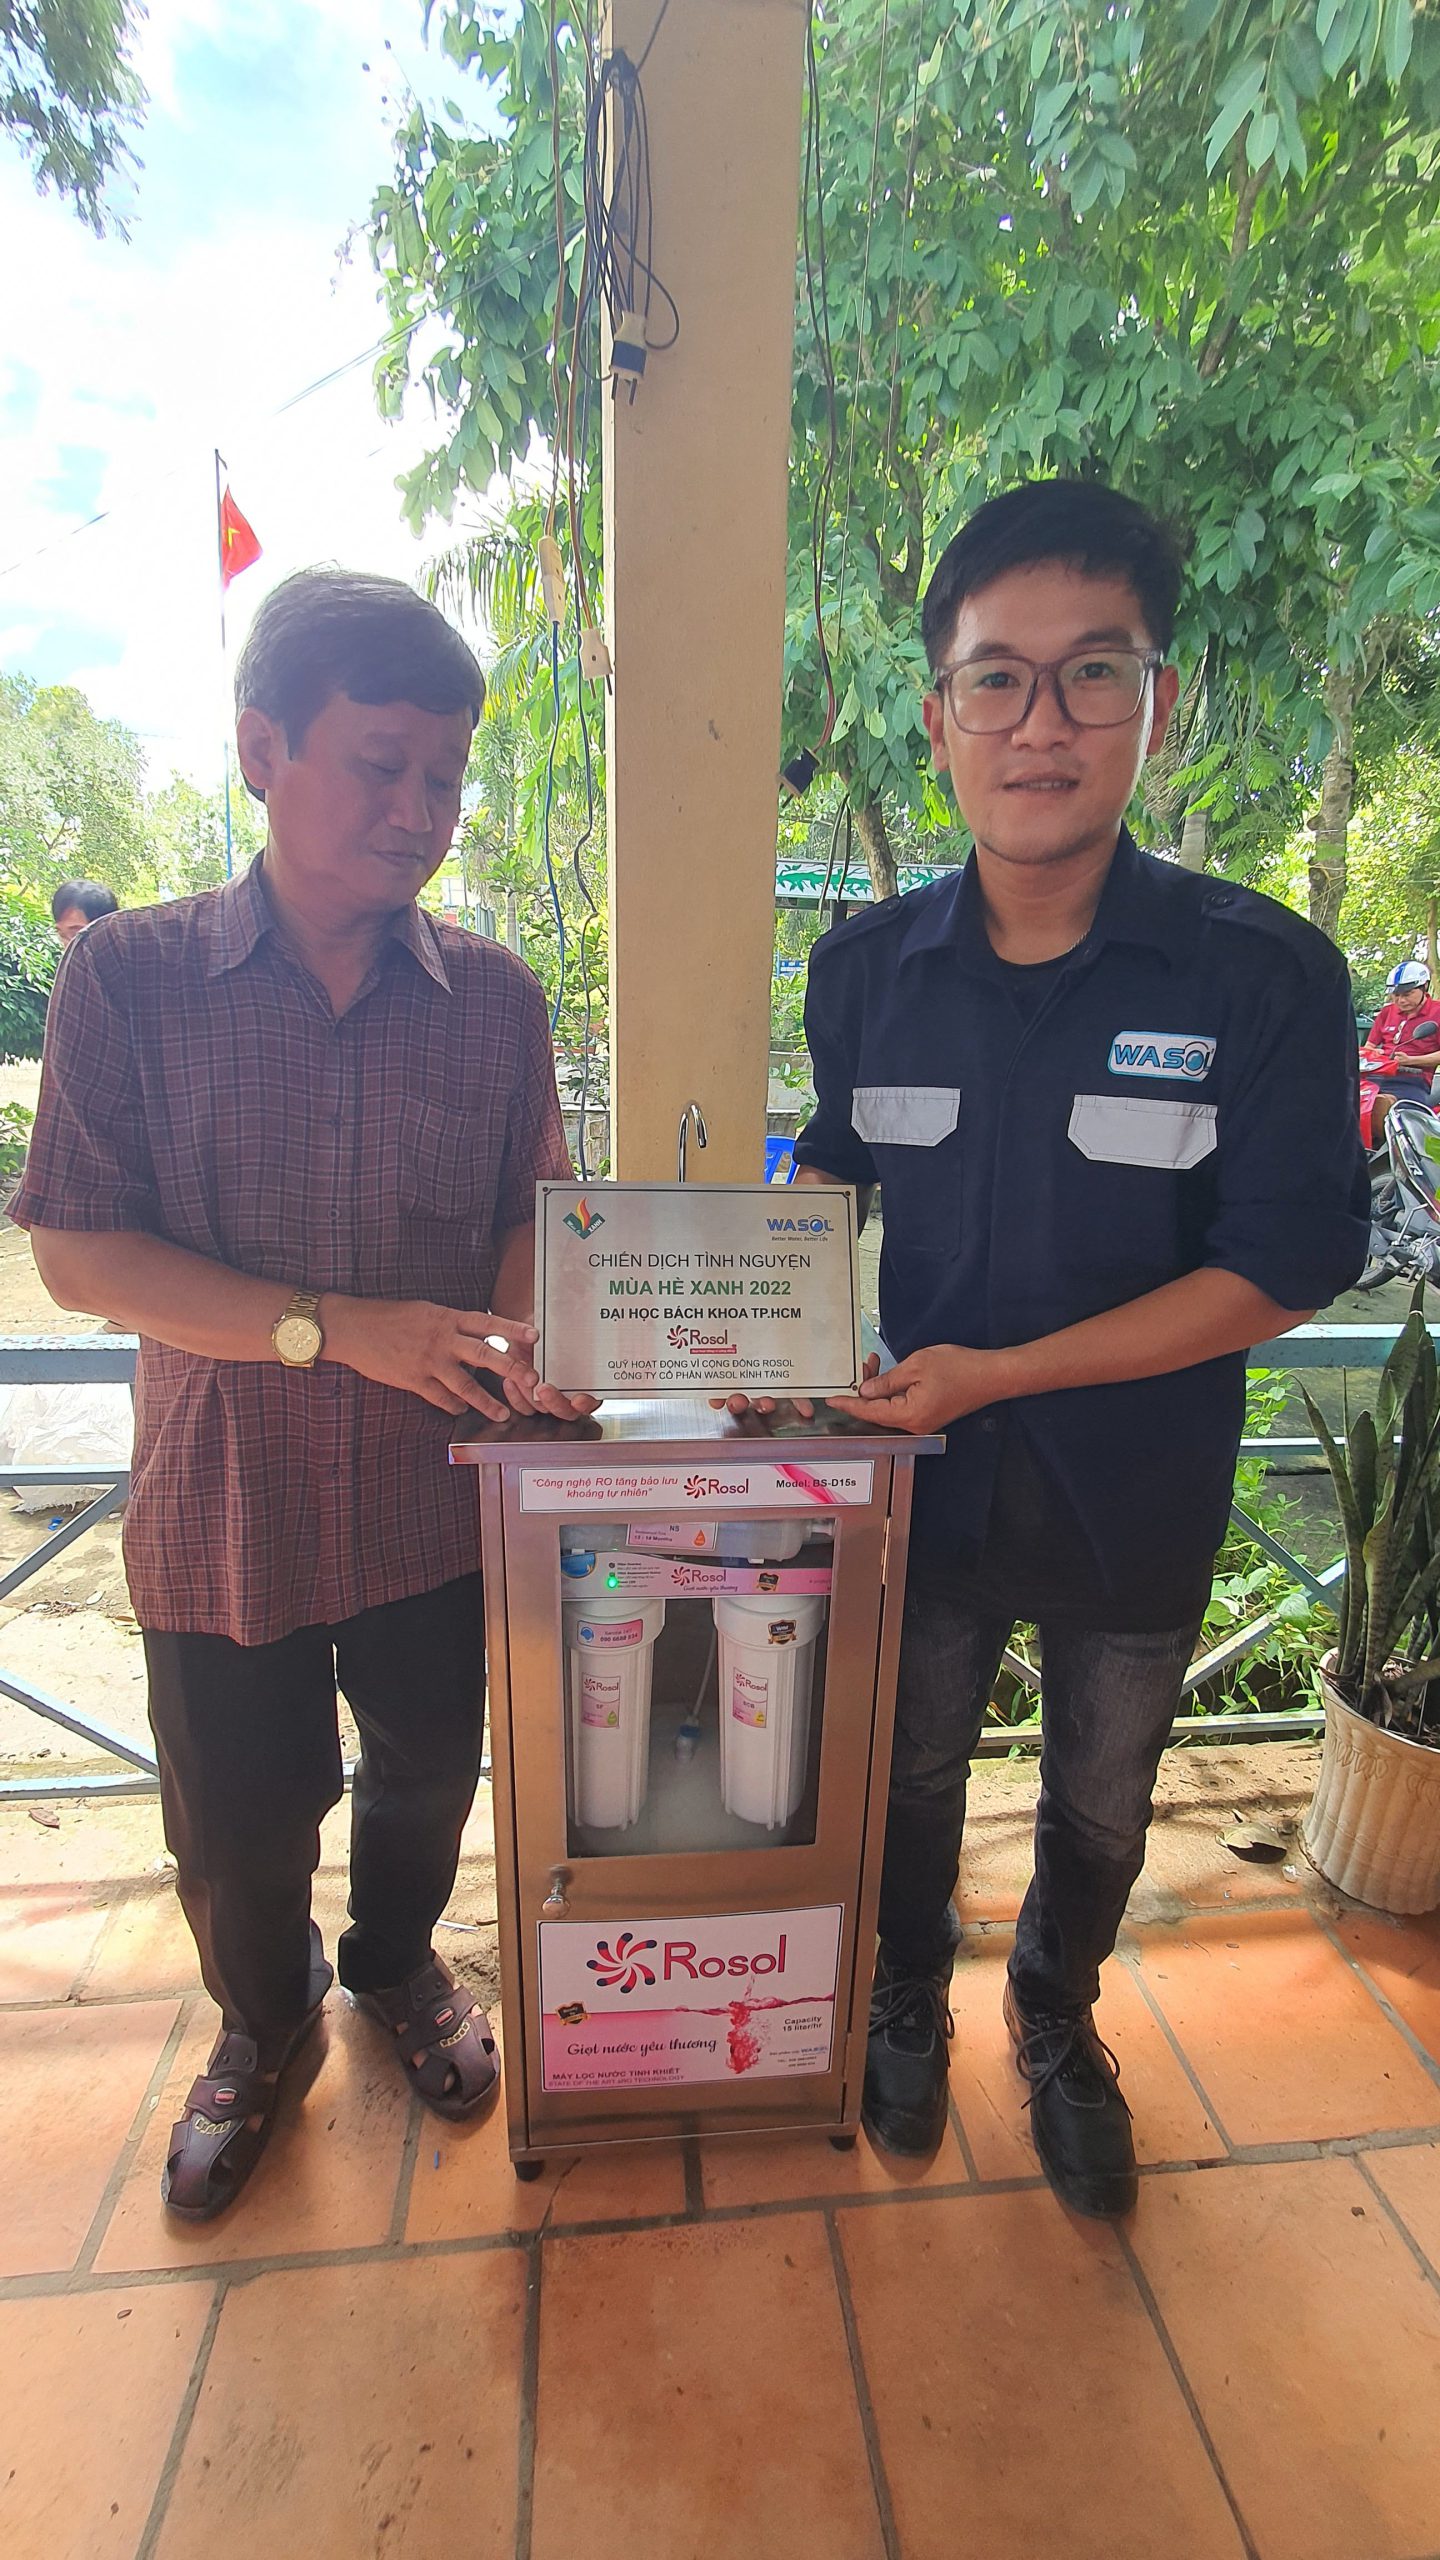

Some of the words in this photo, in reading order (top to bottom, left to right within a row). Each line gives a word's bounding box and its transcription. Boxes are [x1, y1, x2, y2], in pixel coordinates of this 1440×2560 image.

[766, 1217, 834, 1233] WASOL
[648, 1253, 690, 1270] DỊCH
[694, 1250, 734, 1268] TÌNH
[739, 1253, 811, 1271] NGUYỆN
[609, 1276, 653, 1295] MÙA
[658, 1276, 685, 1295] HÈ
[690, 1280, 744, 1295] XANH
[749, 1280, 792, 1295] 2022
[600, 1307, 625, 1322] ĐẠI
[628, 1307, 660, 1322] HỌC
[663, 1305, 704, 1319] BÁCH
[707, 1307, 749, 1319] KHOA
[751, 1307, 801, 1319] TP.HCM
[689, 1328, 728, 1345] Rosol
[762, 1359, 795, 1368] ROSOL
[613, 1370, 642, 1380] CÔNG
[645, 1371, 657, 1380] TY
[704, 1371, 738, 1379] WASOL
[566, 1478, 592, 1488] nghệ
[595, 1477, 613, 1486] RO
[615, 1477, 638, 1487] tăng
[640, 1475, 660, 1486] bảo
[661, 1476, 678, 1485] lưu
[708, 1477, 749, 1494] Rosol
[776, 1479, 810, 1488] Model:
[812, 1478, 857, 1488] BS-D15s
[567, 1488, 604, 1499] khoáng
[607, 1489, 619, 1498] tự
[691, 1569, 727, 1583] Rosol
[596, 1682, 619, 1692] Rosol
[745, 1679, 767, 1692] Rosol
[663, 1933, 787, 1981] Rosol
[784, 2016, 822, 2025] Capacity
[602, 2041, 637, 2054] nước
[640, 2041, 665, 2057] yêu
[669, 2038, 717, 2053] thương
[575, 2072, 595, 2080] LỌC
[598, 2071, 626, 2079] NƯỚC
